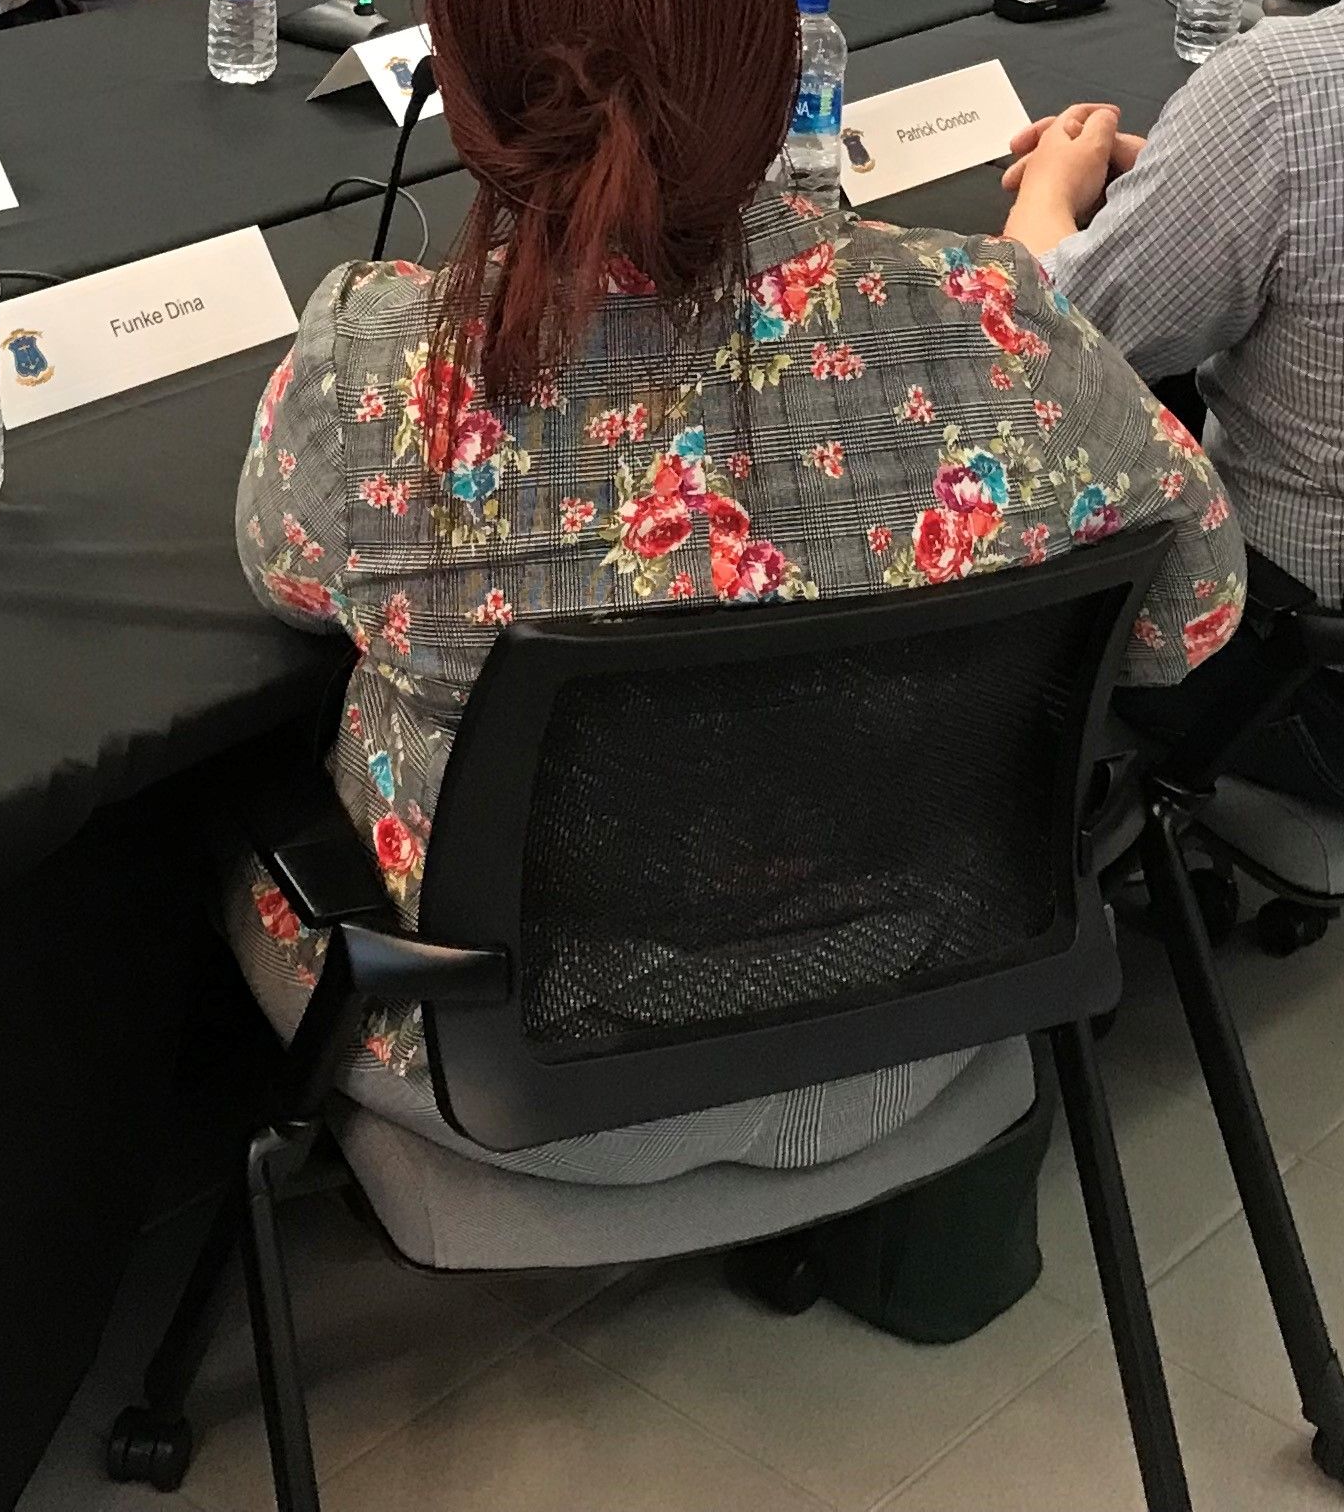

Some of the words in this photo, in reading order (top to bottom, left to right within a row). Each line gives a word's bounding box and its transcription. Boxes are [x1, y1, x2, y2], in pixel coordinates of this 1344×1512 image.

[896, 120, 939, 144] Patrick
[936, 109, 981, 132] Condon
[109, 310, 164, 338] Funke
[164, 296, 206, 320] Dina
